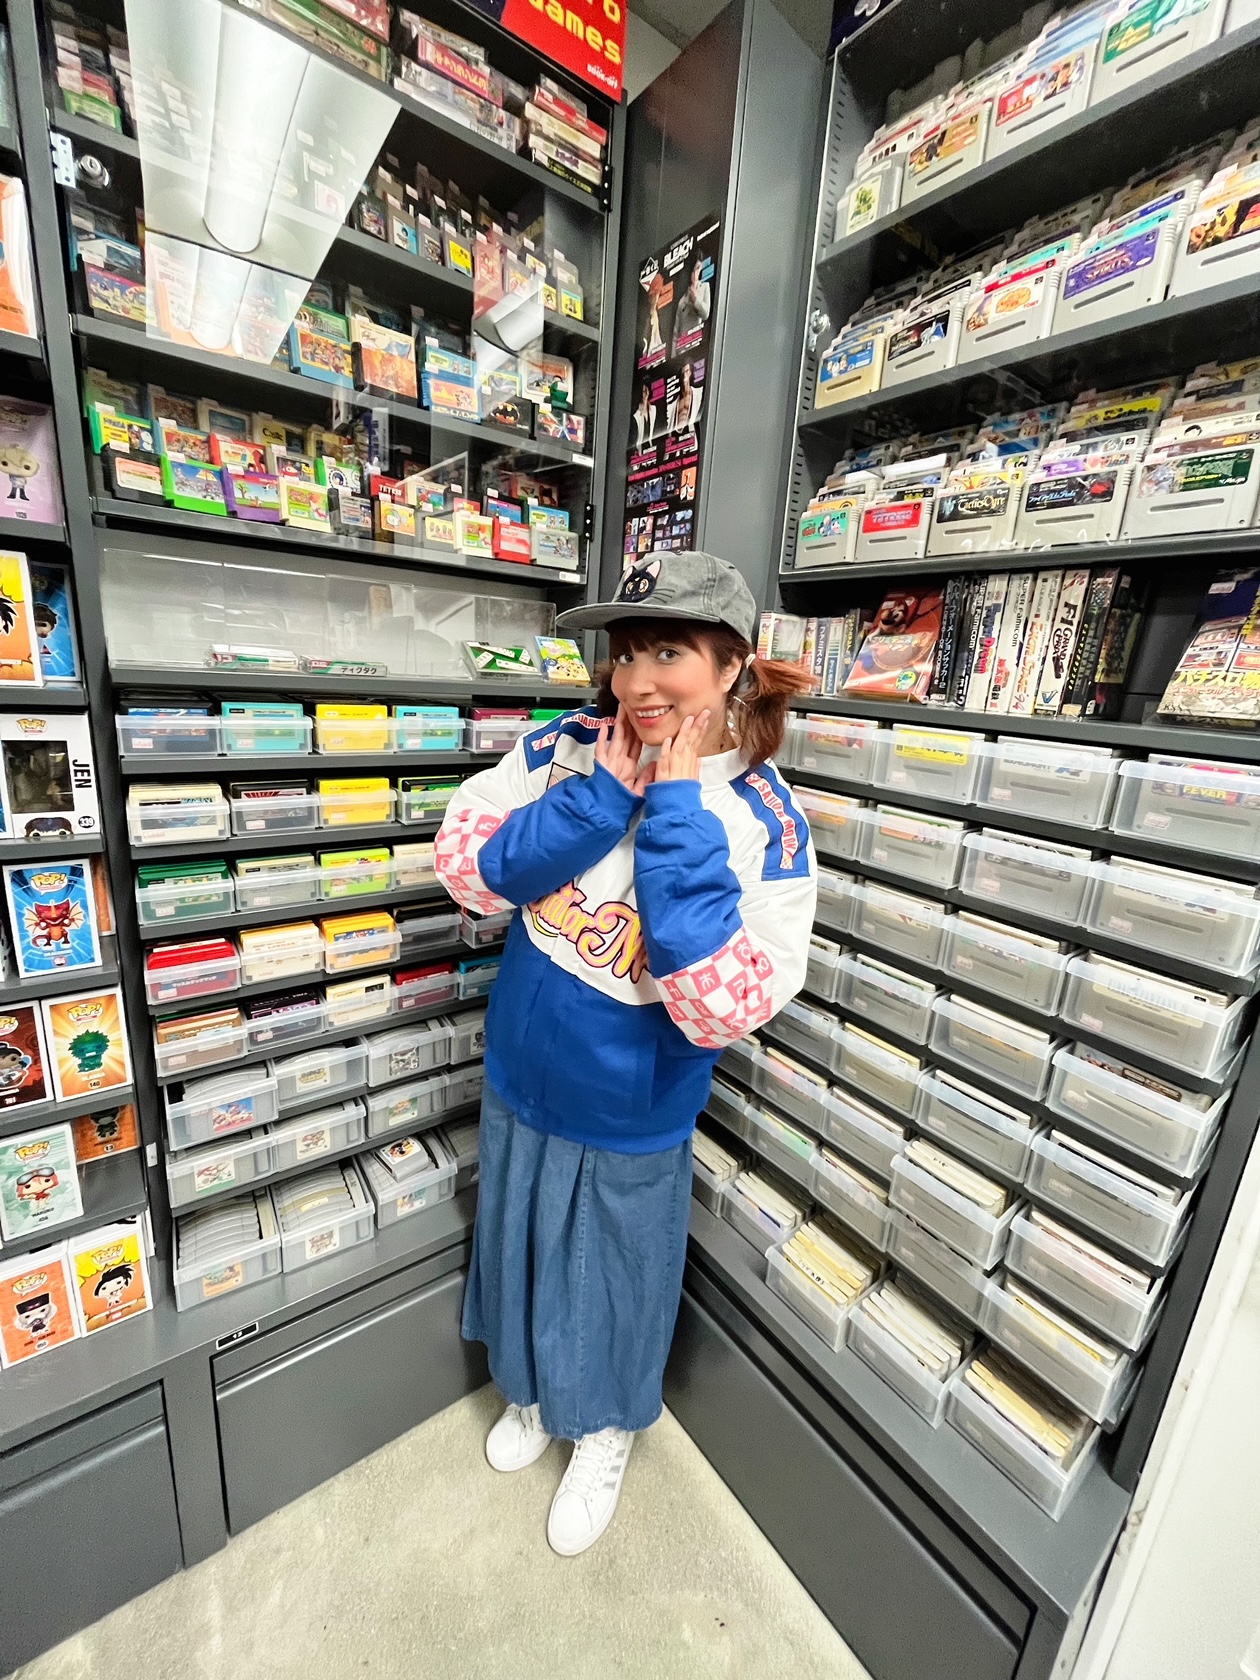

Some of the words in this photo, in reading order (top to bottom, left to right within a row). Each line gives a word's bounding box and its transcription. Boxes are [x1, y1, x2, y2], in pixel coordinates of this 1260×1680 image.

[72, 759, 92, 789] JEN
[1183, 785, 1227, 799] FEVER
[79, 817, 94, 827] 339
